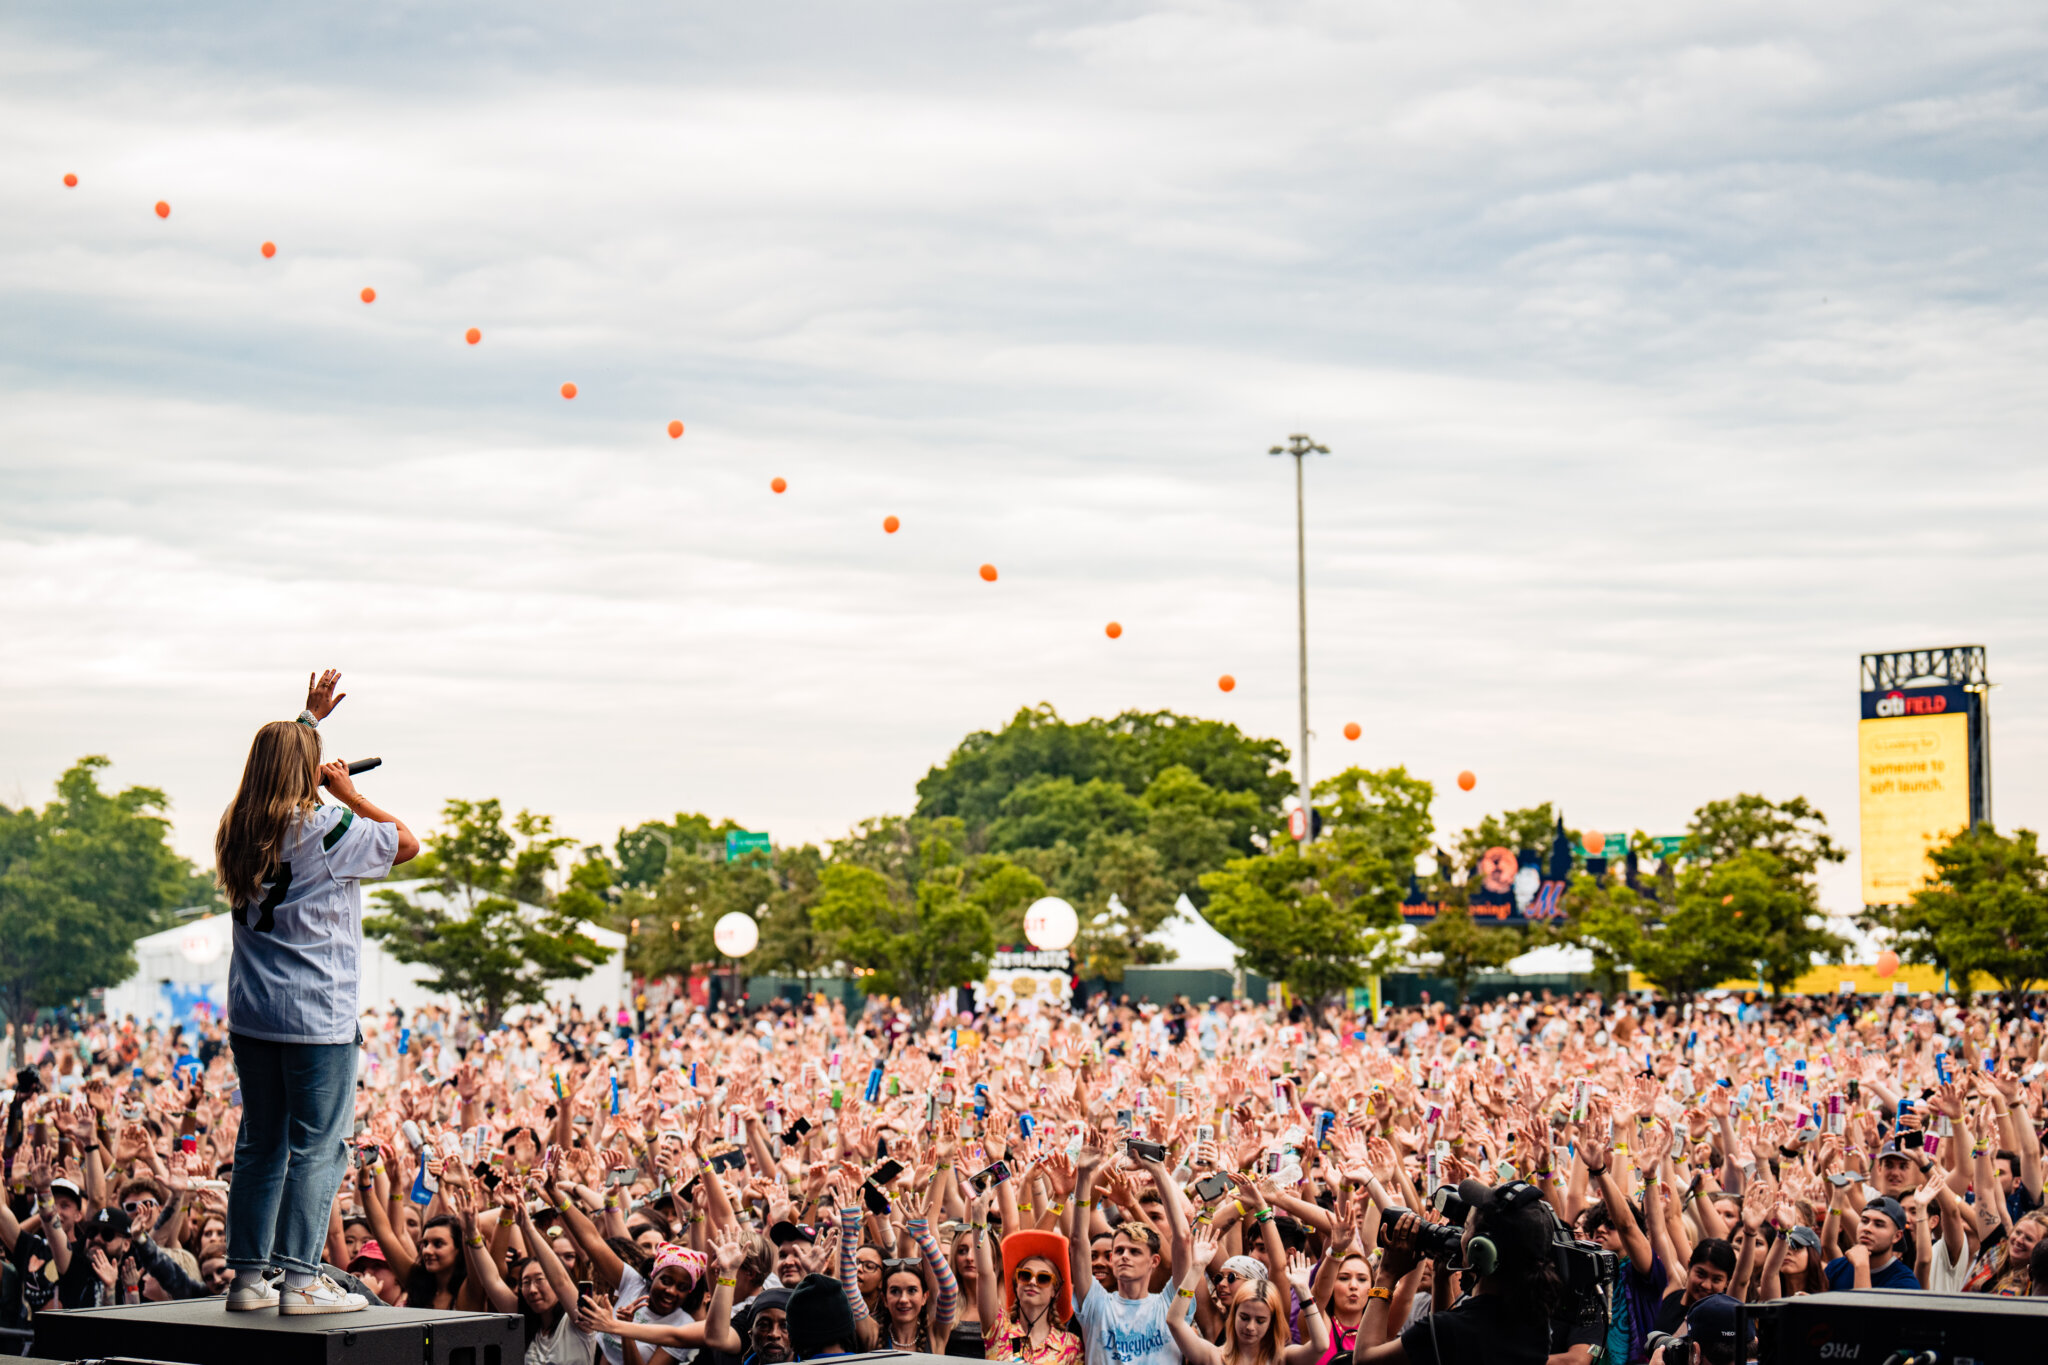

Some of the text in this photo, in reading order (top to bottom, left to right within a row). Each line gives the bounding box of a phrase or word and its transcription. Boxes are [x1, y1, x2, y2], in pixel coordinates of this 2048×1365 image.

[1876, 692, 1947, 717] citi FIELD
[1869, 759, 1945, 775] someone to
[1869, 778, 1894, 794] soft
[1399, 901, 1436, 916] hanks
